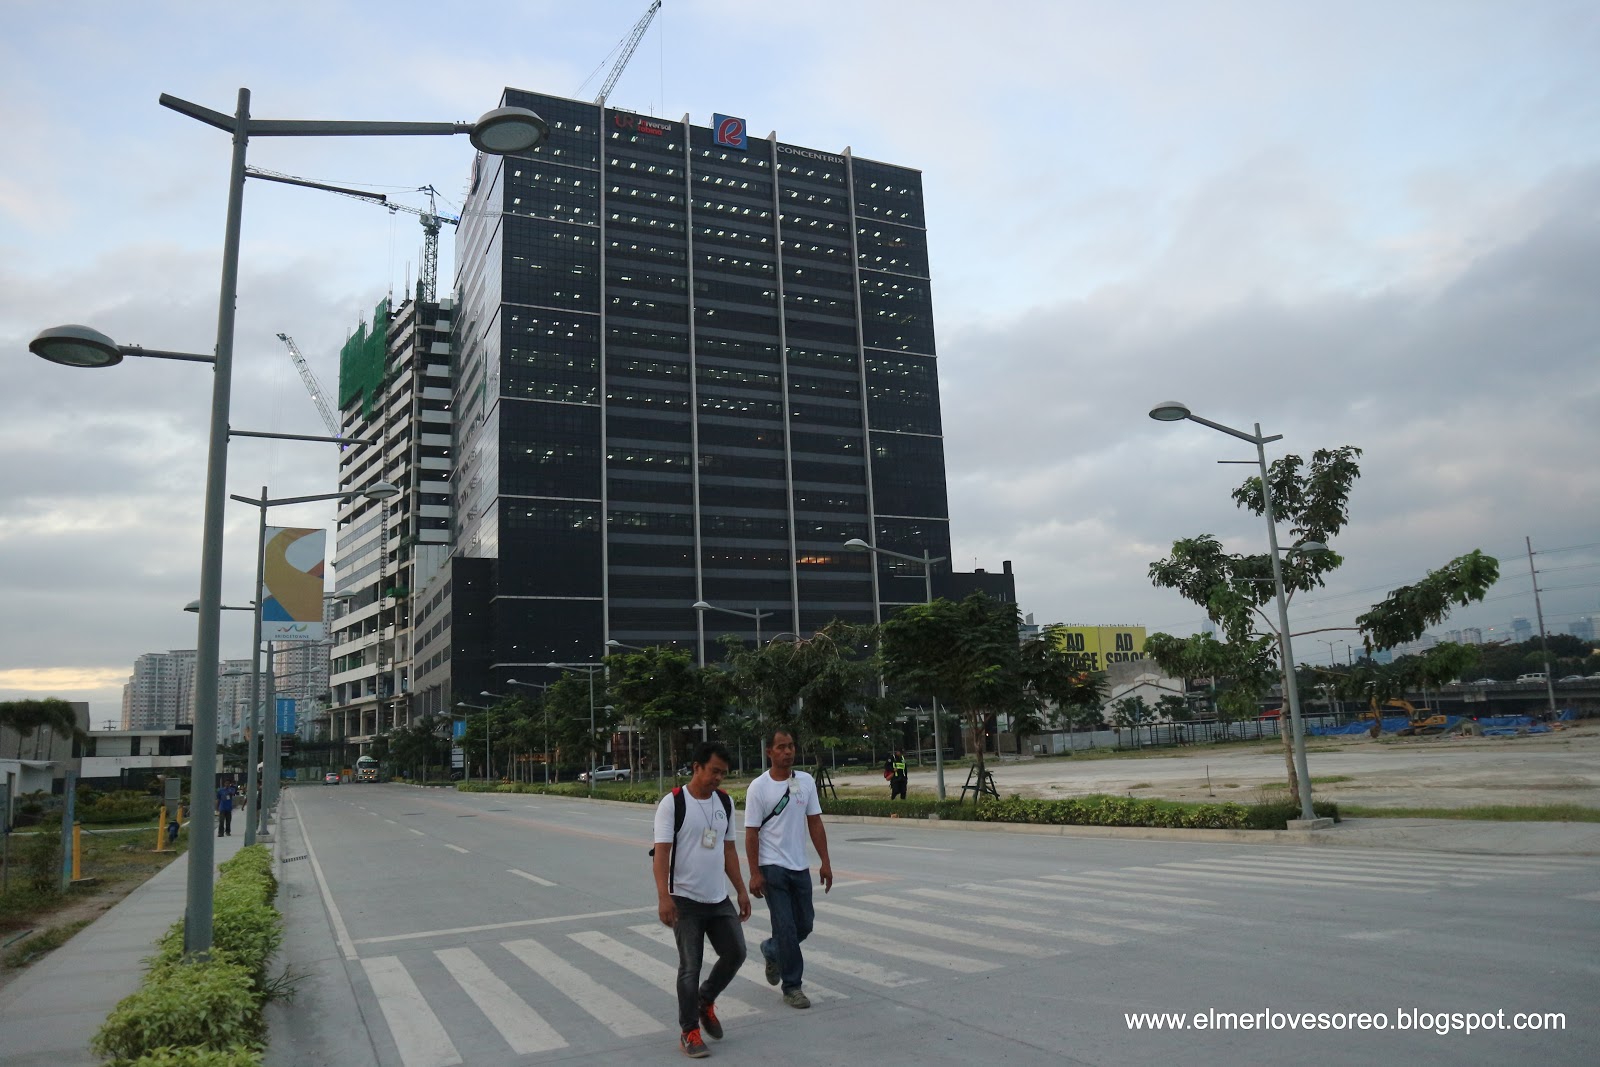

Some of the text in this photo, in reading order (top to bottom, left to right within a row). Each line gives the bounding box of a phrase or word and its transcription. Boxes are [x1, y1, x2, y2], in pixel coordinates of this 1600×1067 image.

[718, 118, 742, 145] R
[777, 146, 844, 164] CONCENTRIX
[1067, 633, 1085, 652] AD
[1115, 633, 1133, 652] AD
[1060, 652, 1099, 671] PACE
